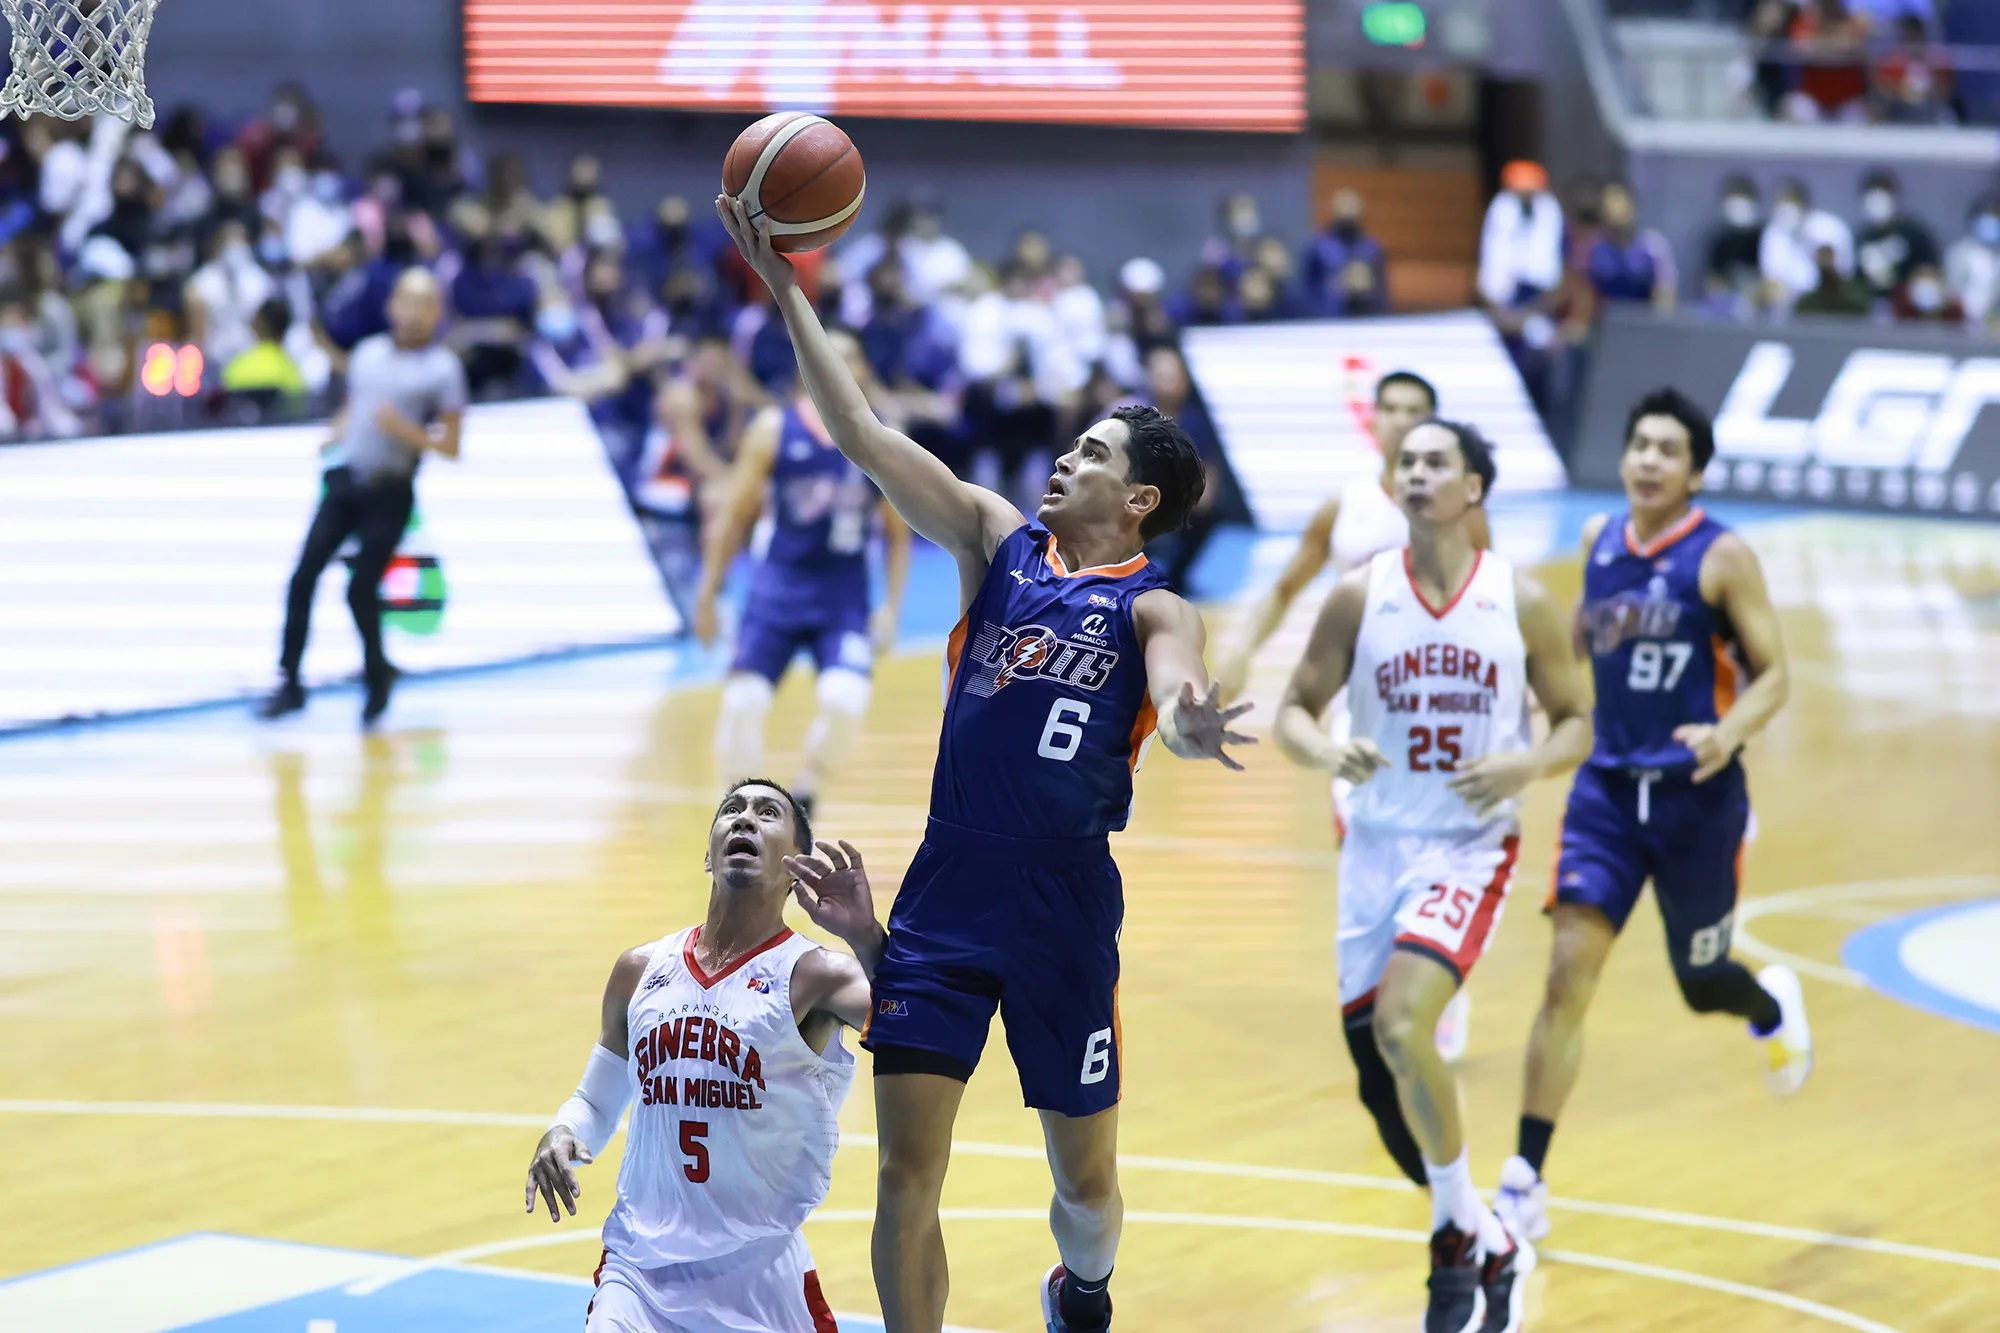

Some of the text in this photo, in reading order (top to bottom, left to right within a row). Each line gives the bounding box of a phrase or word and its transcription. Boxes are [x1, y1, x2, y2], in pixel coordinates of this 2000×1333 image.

[984, 624, 1119, 691] BOLTS
[1071, 633, 1107, 647] MERALCO
[1375, 643, 1499, 700] GINEBRA
[1628, 641, 1694, 692] 97
[1037, 697, 1091, 762] 6
[1408, 726, 1463, 772] 25
[1417, 883, 1474, 930] 25
[658, 1004, 739, 1026] BARANGAY
[879, 999, 908, 1016] PBA
[634, 1016, 766, 1091] GINEBRA
[1081, 1027, 1111, 1084] 6
[642, 1076, 762, 1110] SAN MIGUEL
[679, 1120, 710, 1183] 5
